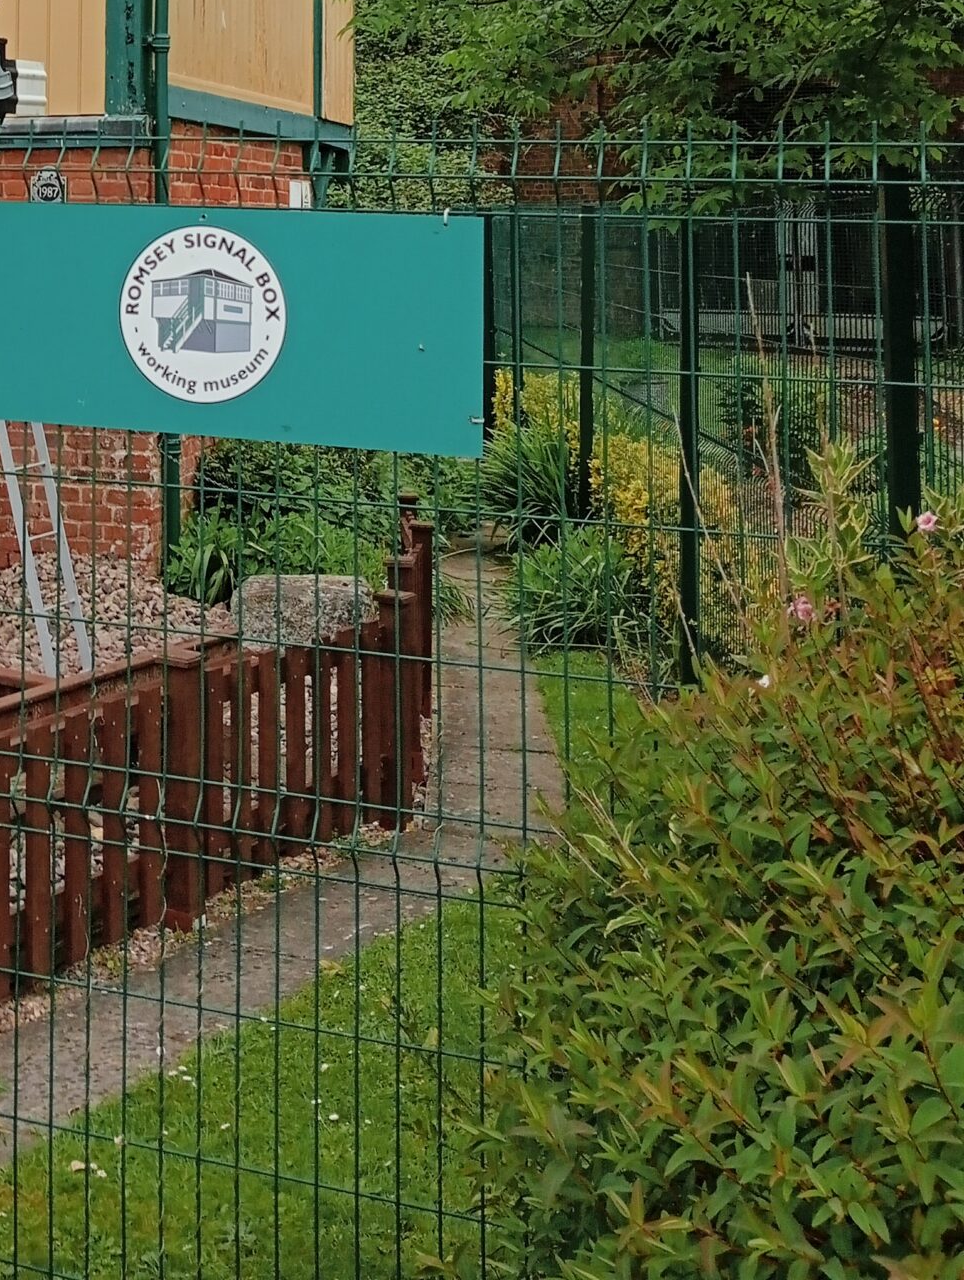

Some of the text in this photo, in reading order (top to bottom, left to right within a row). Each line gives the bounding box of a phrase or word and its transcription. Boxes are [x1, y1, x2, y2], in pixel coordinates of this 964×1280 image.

[38, 186, 59, 199] 1987
[125, 233, 280, 322] ROMSEY SIGNAL BOX
[138, 342, 269, 395] working museum
